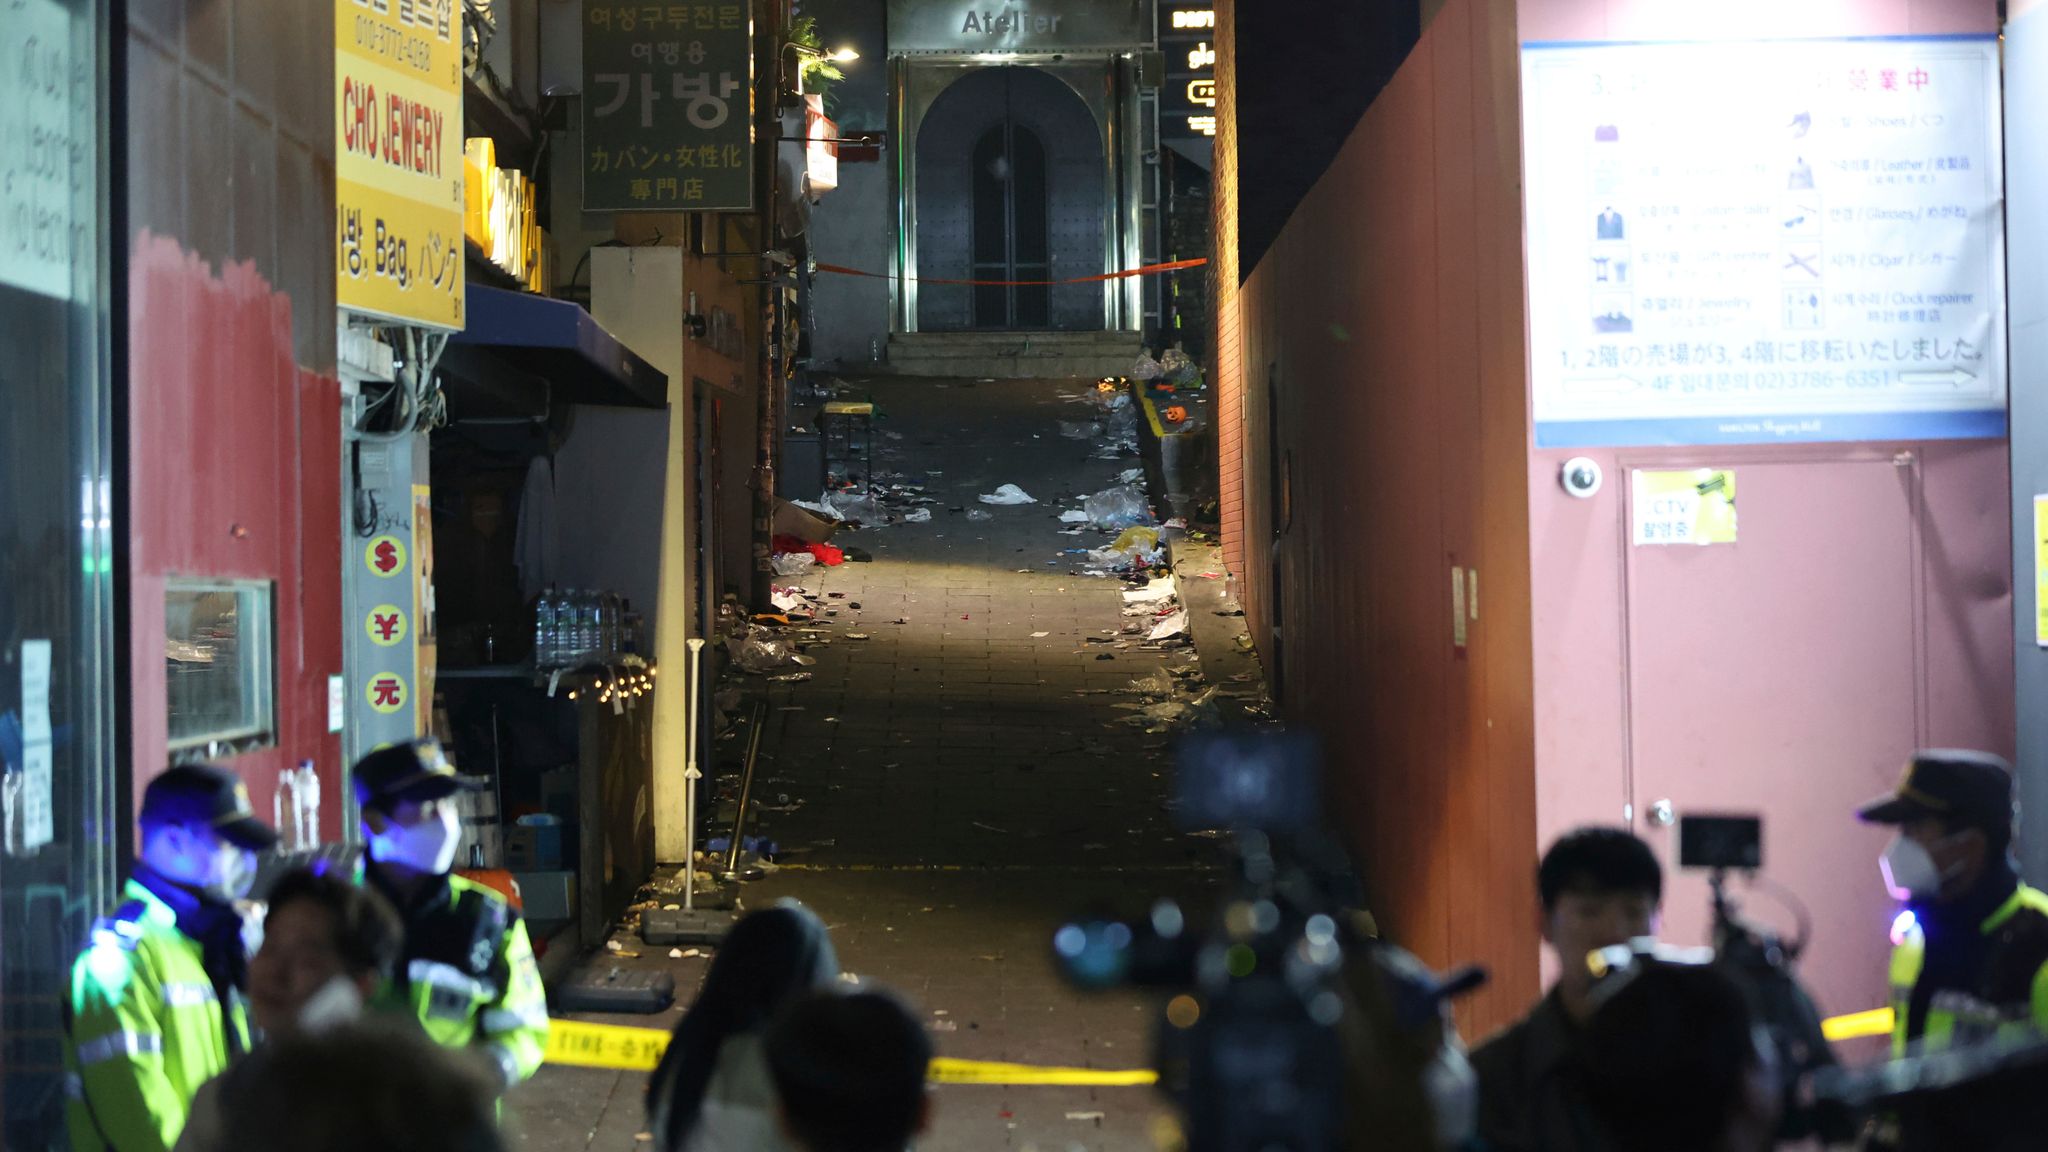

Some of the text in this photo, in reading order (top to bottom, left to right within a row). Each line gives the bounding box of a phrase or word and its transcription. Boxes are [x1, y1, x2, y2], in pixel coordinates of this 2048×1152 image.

[590, 5, 741, 31] 여성구두전문
[962, 10, 1061, 33] Atelier
[631, 40, 707, 65] 여행용
[594, 72, 741, 129] 가방
[343, 75, 443, 179] CHO JEWERY
[375, 217, 414, 289] Bag,
[1891, 291, 1924, 305] Clock
[1927, 292, 1975, 308] repairer
[374, 540, 398, 573] $
[374, 614, 399, 641] ¥
[373, 679, 400, 706] 元
